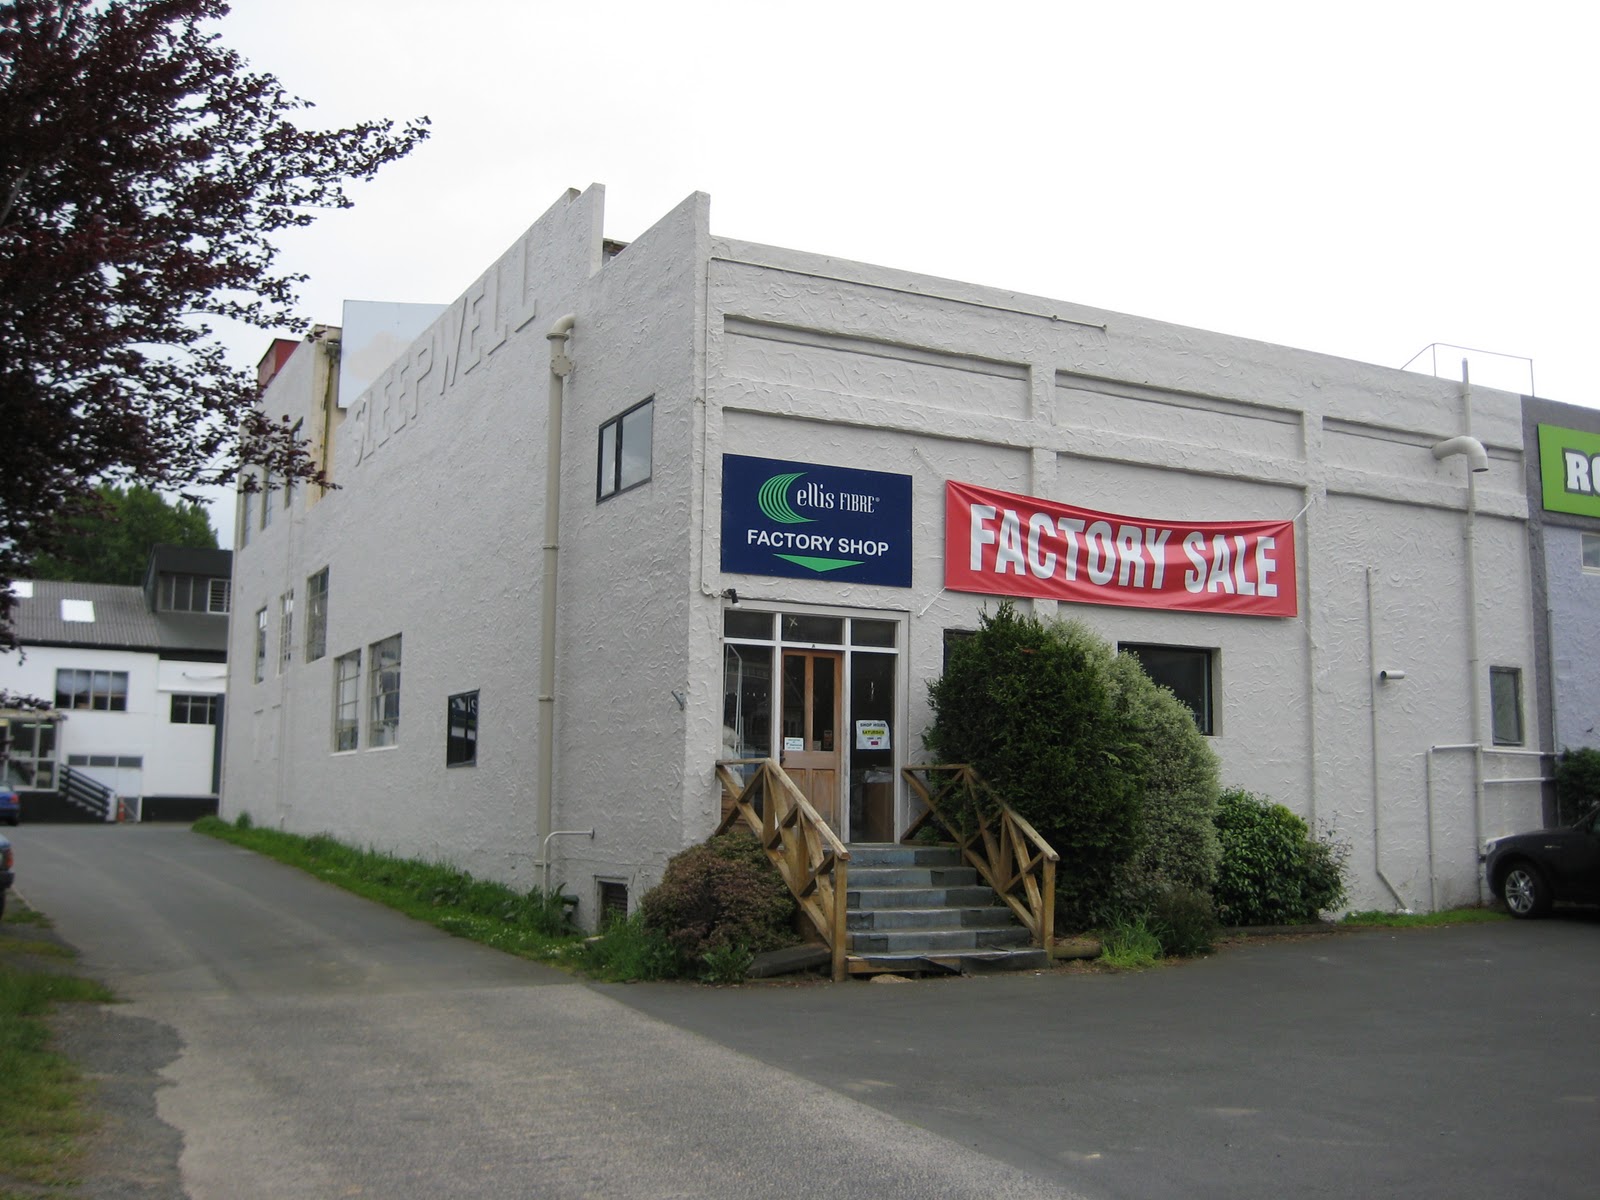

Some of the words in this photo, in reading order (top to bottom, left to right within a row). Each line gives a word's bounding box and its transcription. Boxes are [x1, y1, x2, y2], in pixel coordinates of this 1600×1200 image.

[353, 236, 537, 467] SLEEPWELL
[796, 482, 835, 509] ellis
[840, 492, 875, 513] FIBRE
[747, 529, 834, 551] FACTORY
[838, 538, 889, 556] SHOP
[969, 503, 1172, 590] FACTORY
[1183, 531, 1278, 597] SALE
